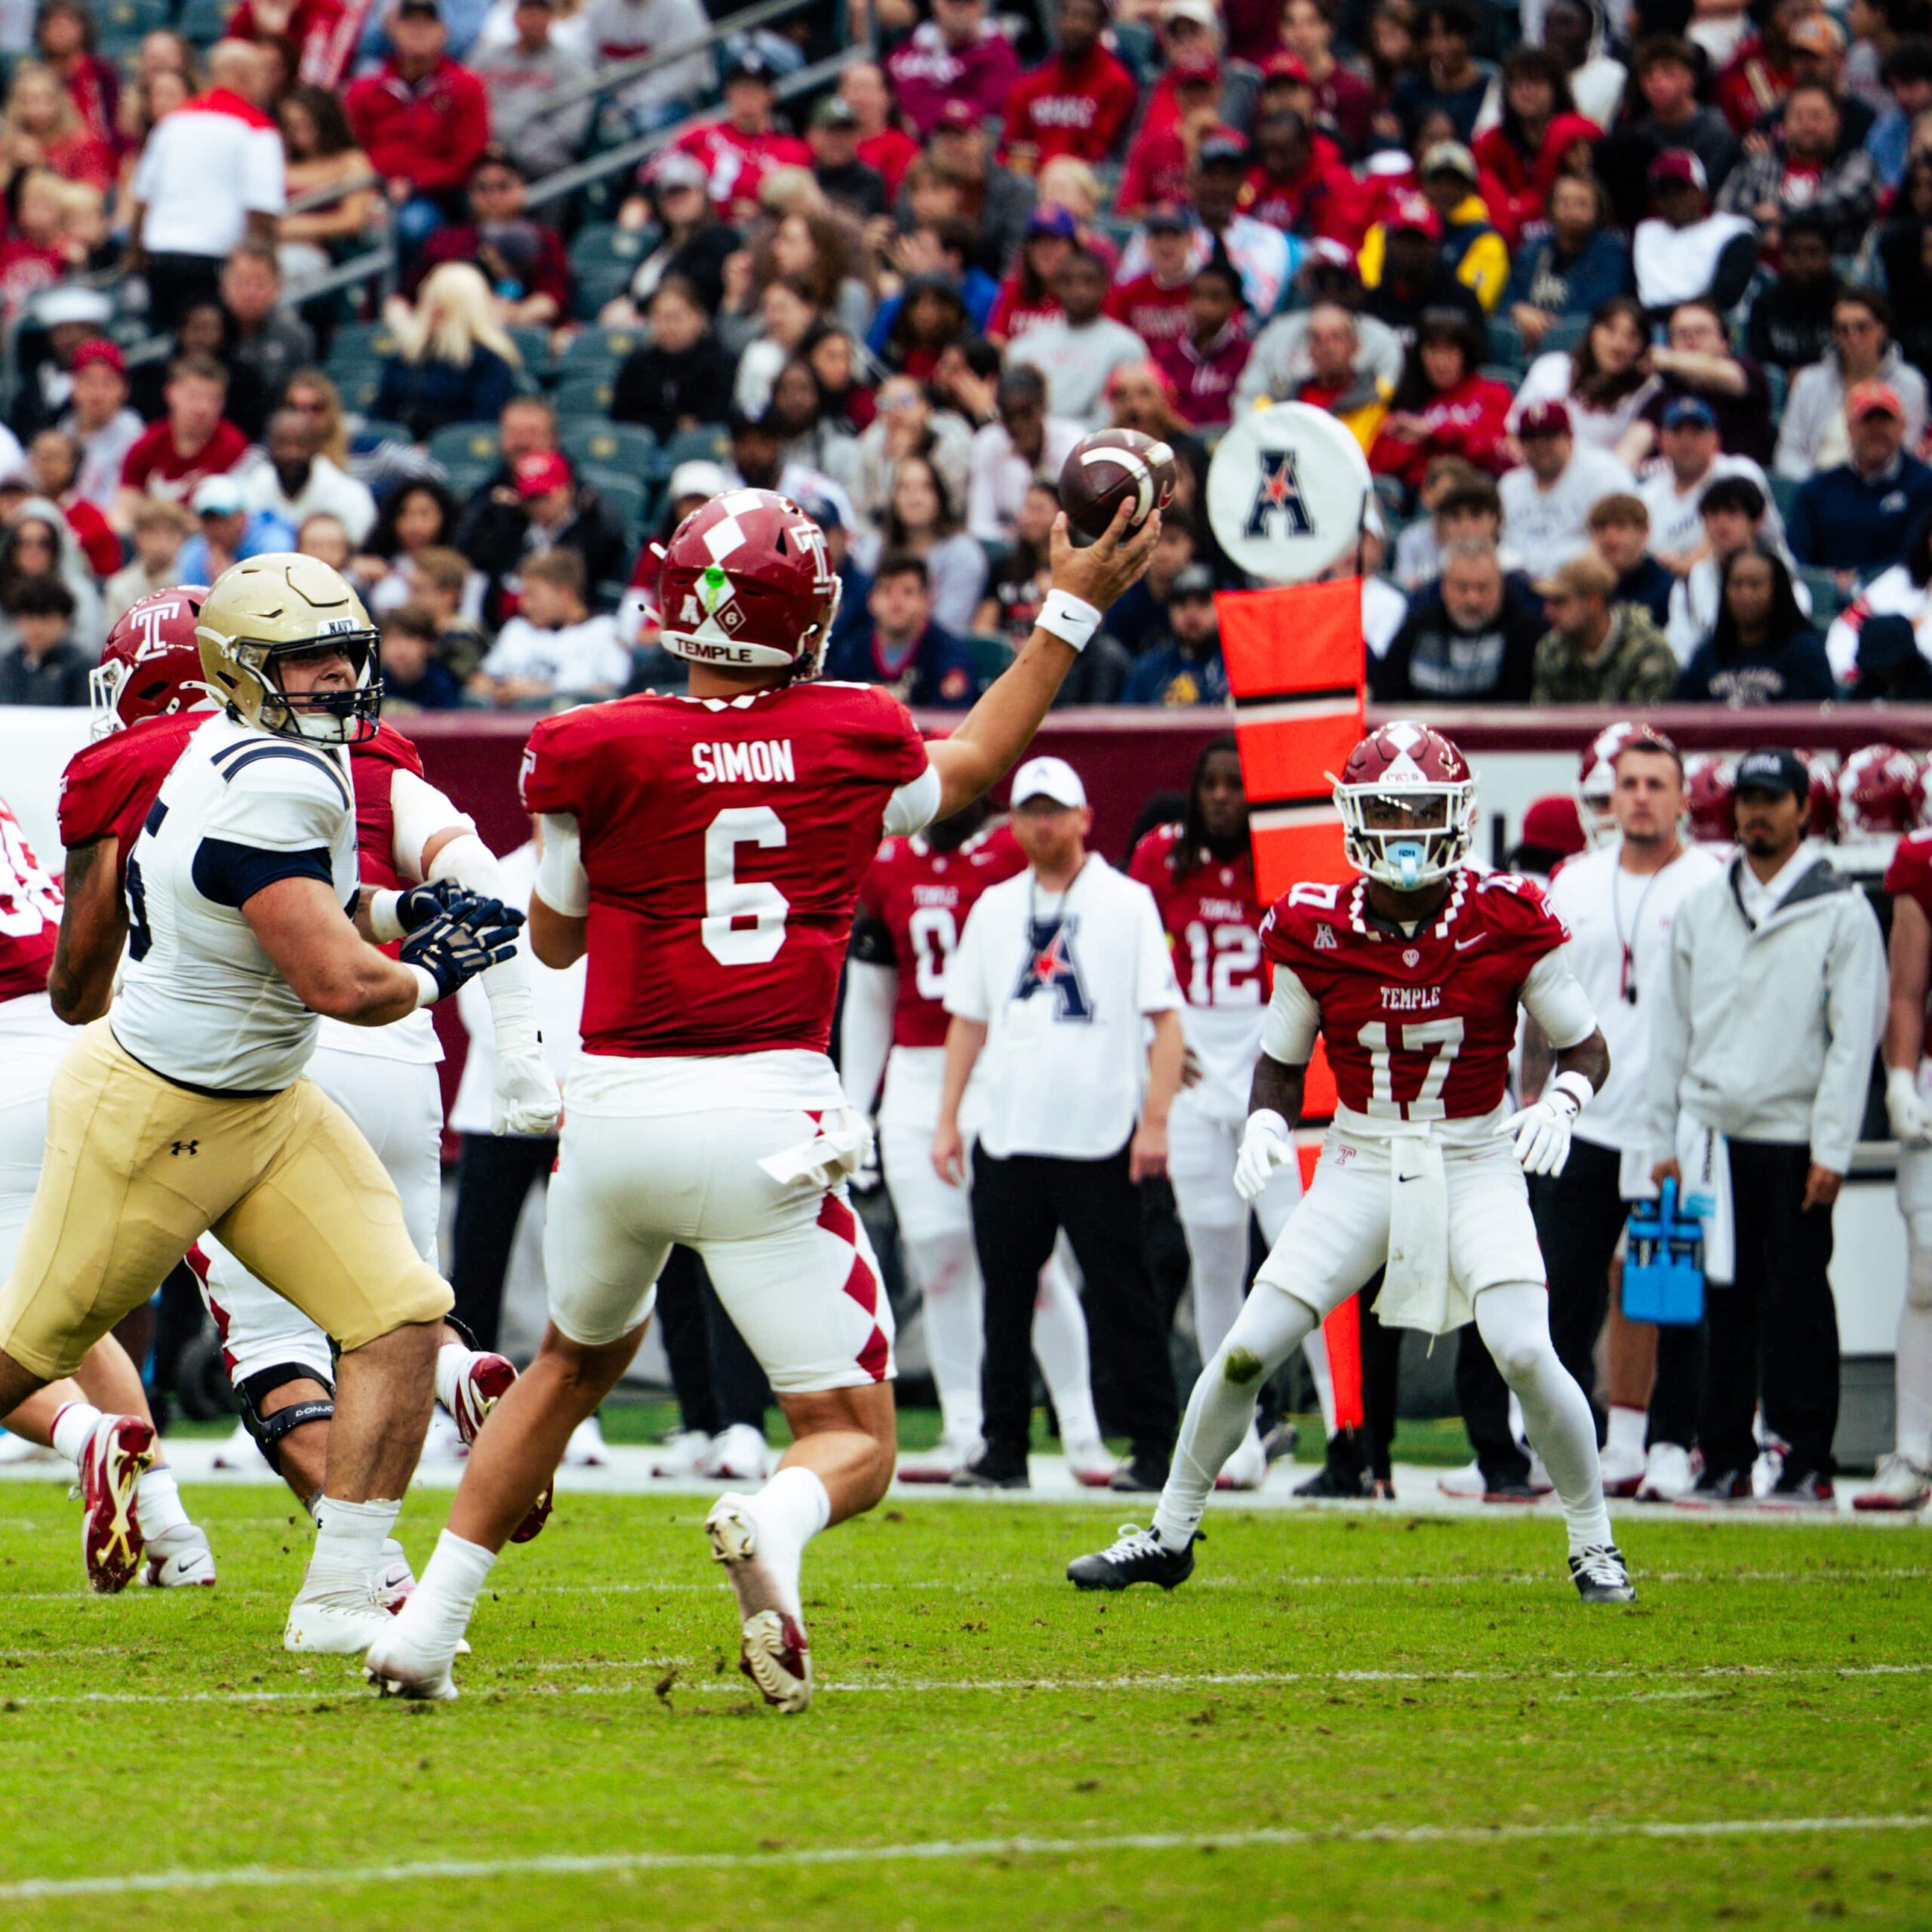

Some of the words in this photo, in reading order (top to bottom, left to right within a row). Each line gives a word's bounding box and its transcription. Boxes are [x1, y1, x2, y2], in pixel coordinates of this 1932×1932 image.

[1242, 448, 1315, 537] A
[130, 601, 180, 661] T
[328, 619, 353, 635] NAVY
[674, 637, 752, 663] TEMPLE
[725, 611, 737, 626] 6
[691, 739, 795, 783] SIMON
[701, 805, 791, 966] 6
[909, 906, 958, 1000] 0
[1001, 913, 1097, 1023] A
[1185, 919, 1261, 1006] 12
[1380, 986, 1441, 1010] TEMPLE
[1358, 1016, 1465, 1121] 17
